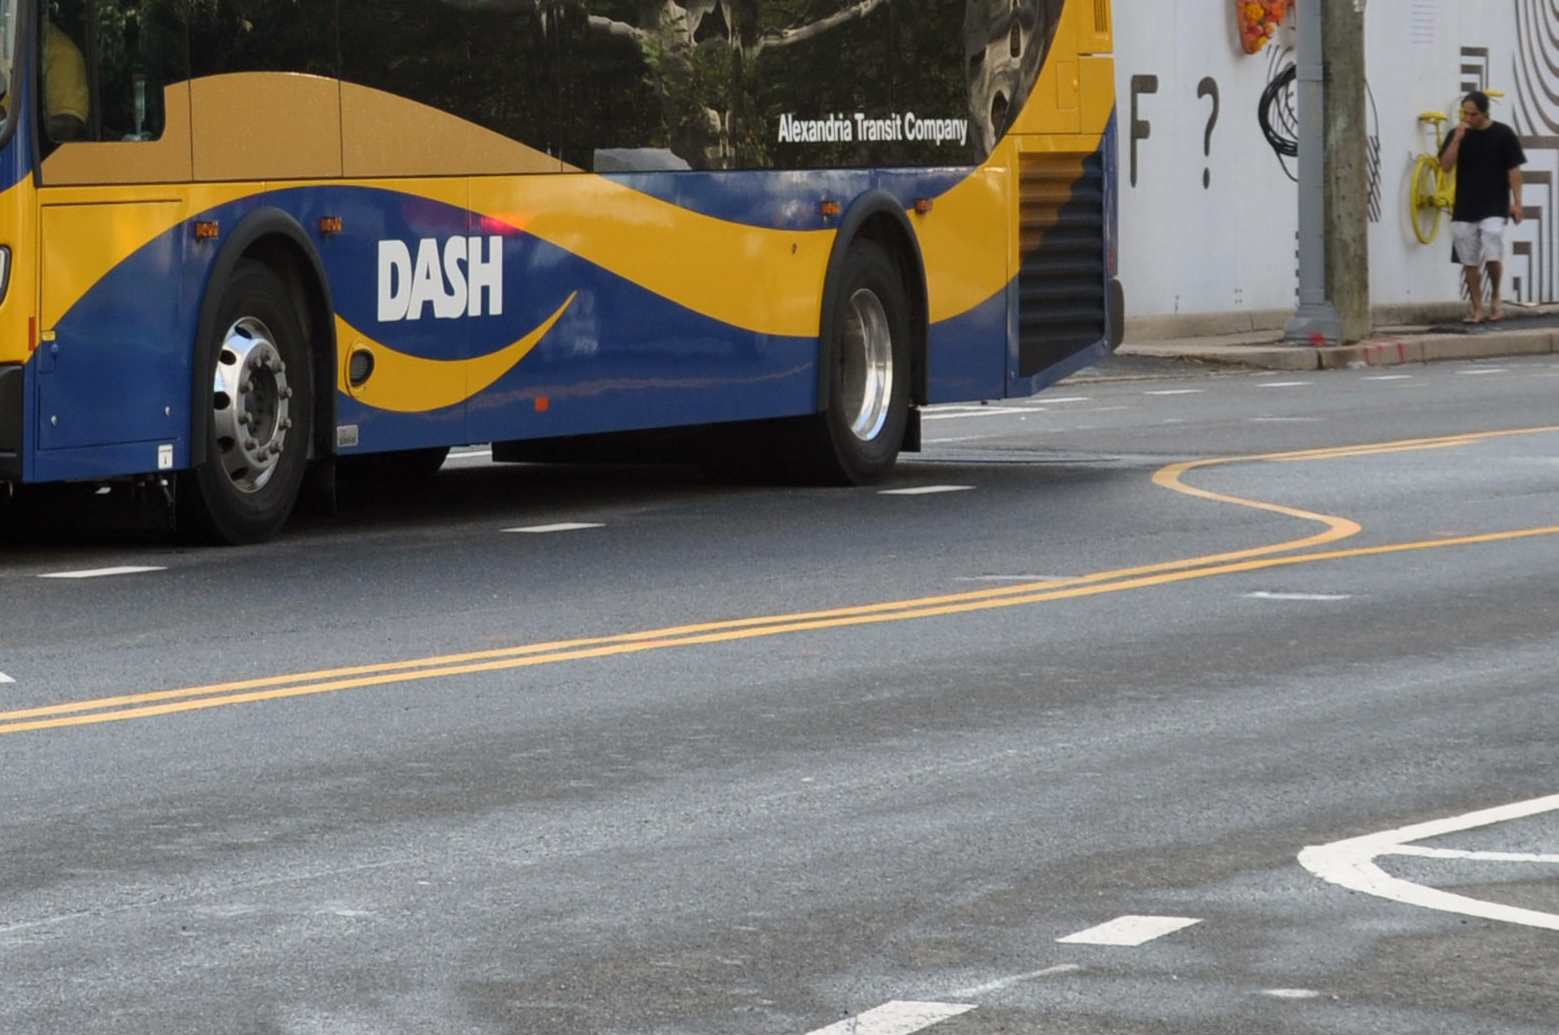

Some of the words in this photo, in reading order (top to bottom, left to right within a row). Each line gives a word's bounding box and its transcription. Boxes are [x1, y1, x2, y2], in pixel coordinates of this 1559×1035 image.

[778, 113, 852, 143] Alexandria
[854, 113, 902, 141] Transit
[904, 112, 968, 147] Company
[378, 235, 503, 322] DASH
